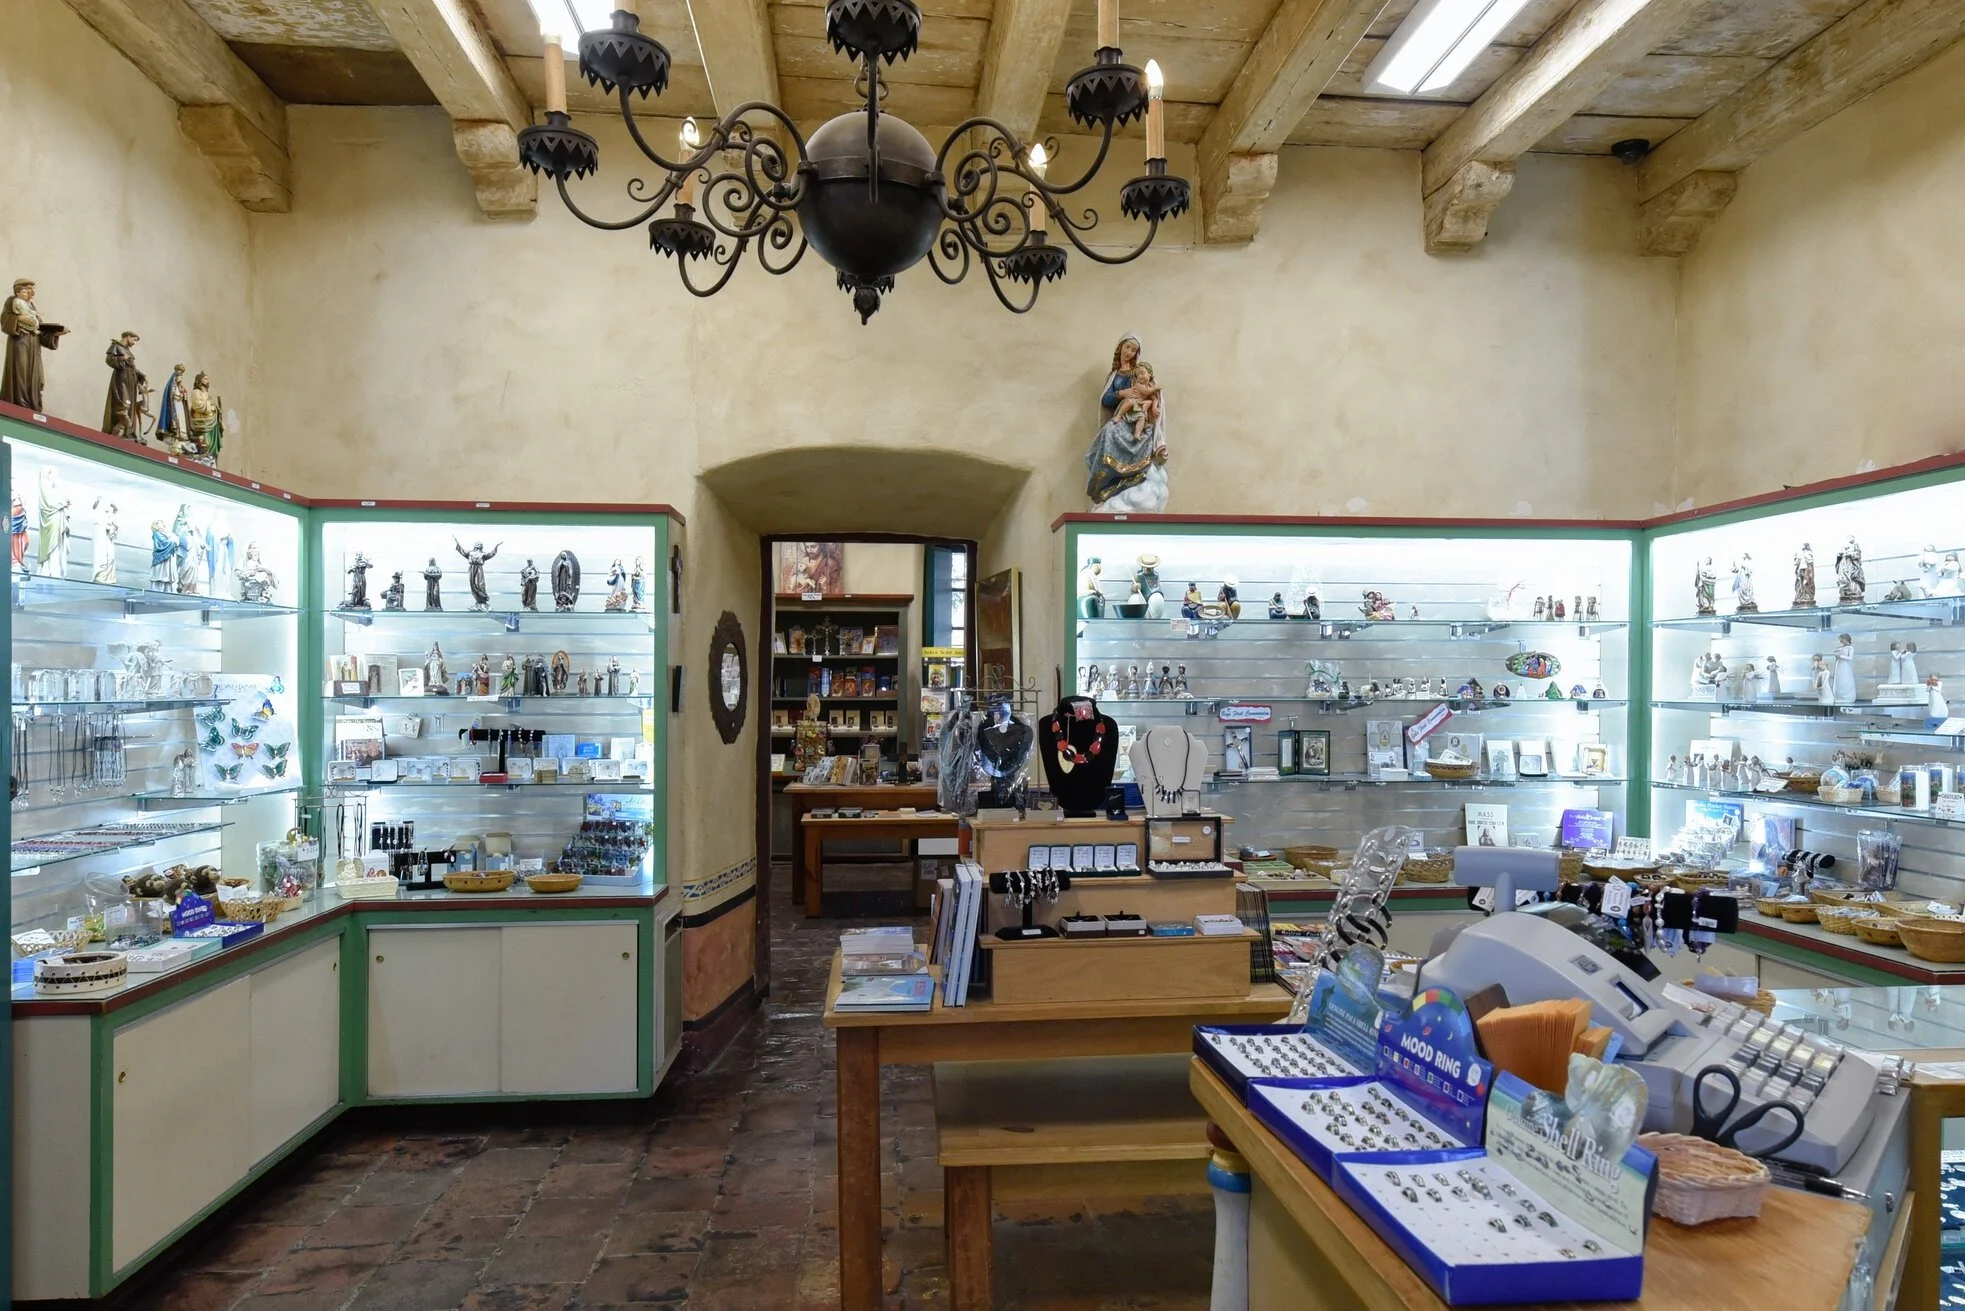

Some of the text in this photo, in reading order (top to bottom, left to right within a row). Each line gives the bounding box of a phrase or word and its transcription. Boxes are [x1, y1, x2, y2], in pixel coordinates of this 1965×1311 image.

[181, 908, 194, 917] MOOD
[1401, 1032, 1434, 1062] MOOD
[1435, 1050, 1461, 1079] RING
[1541, 1113, 1582, 1162] Shell
[1582, 1136, 1622, 1196] Ring
